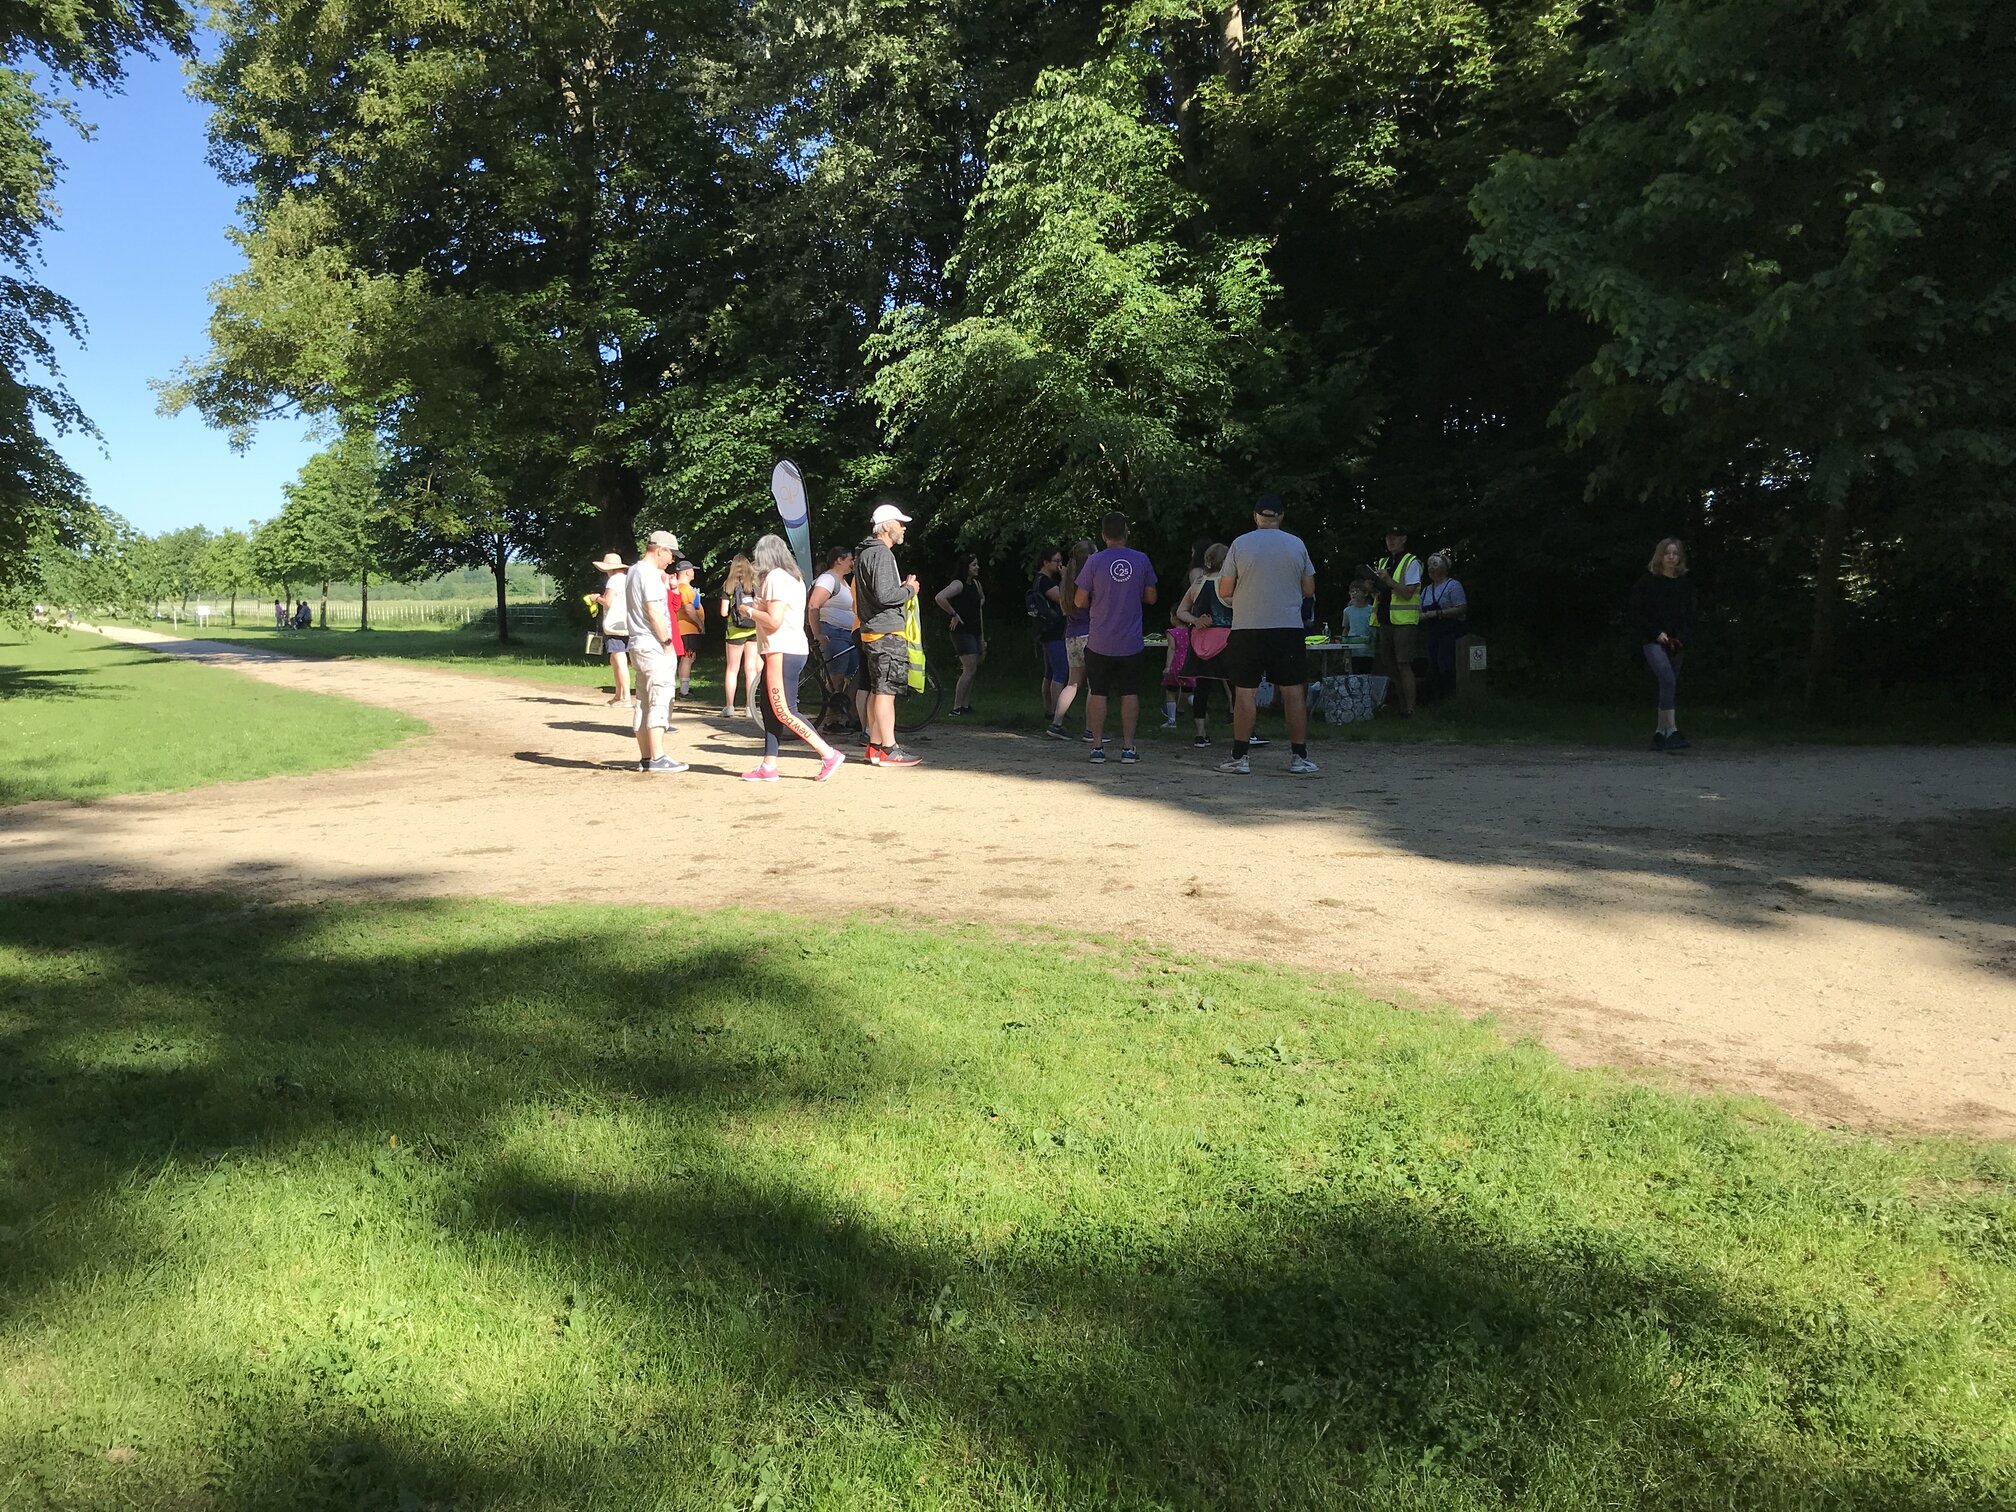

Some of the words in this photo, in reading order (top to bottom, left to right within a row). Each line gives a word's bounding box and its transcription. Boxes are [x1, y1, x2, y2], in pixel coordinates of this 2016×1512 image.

[1119, 568, 1129, 577] 25
[771, 687, 794, 726] balance
[792, 723, 811, 738] new
